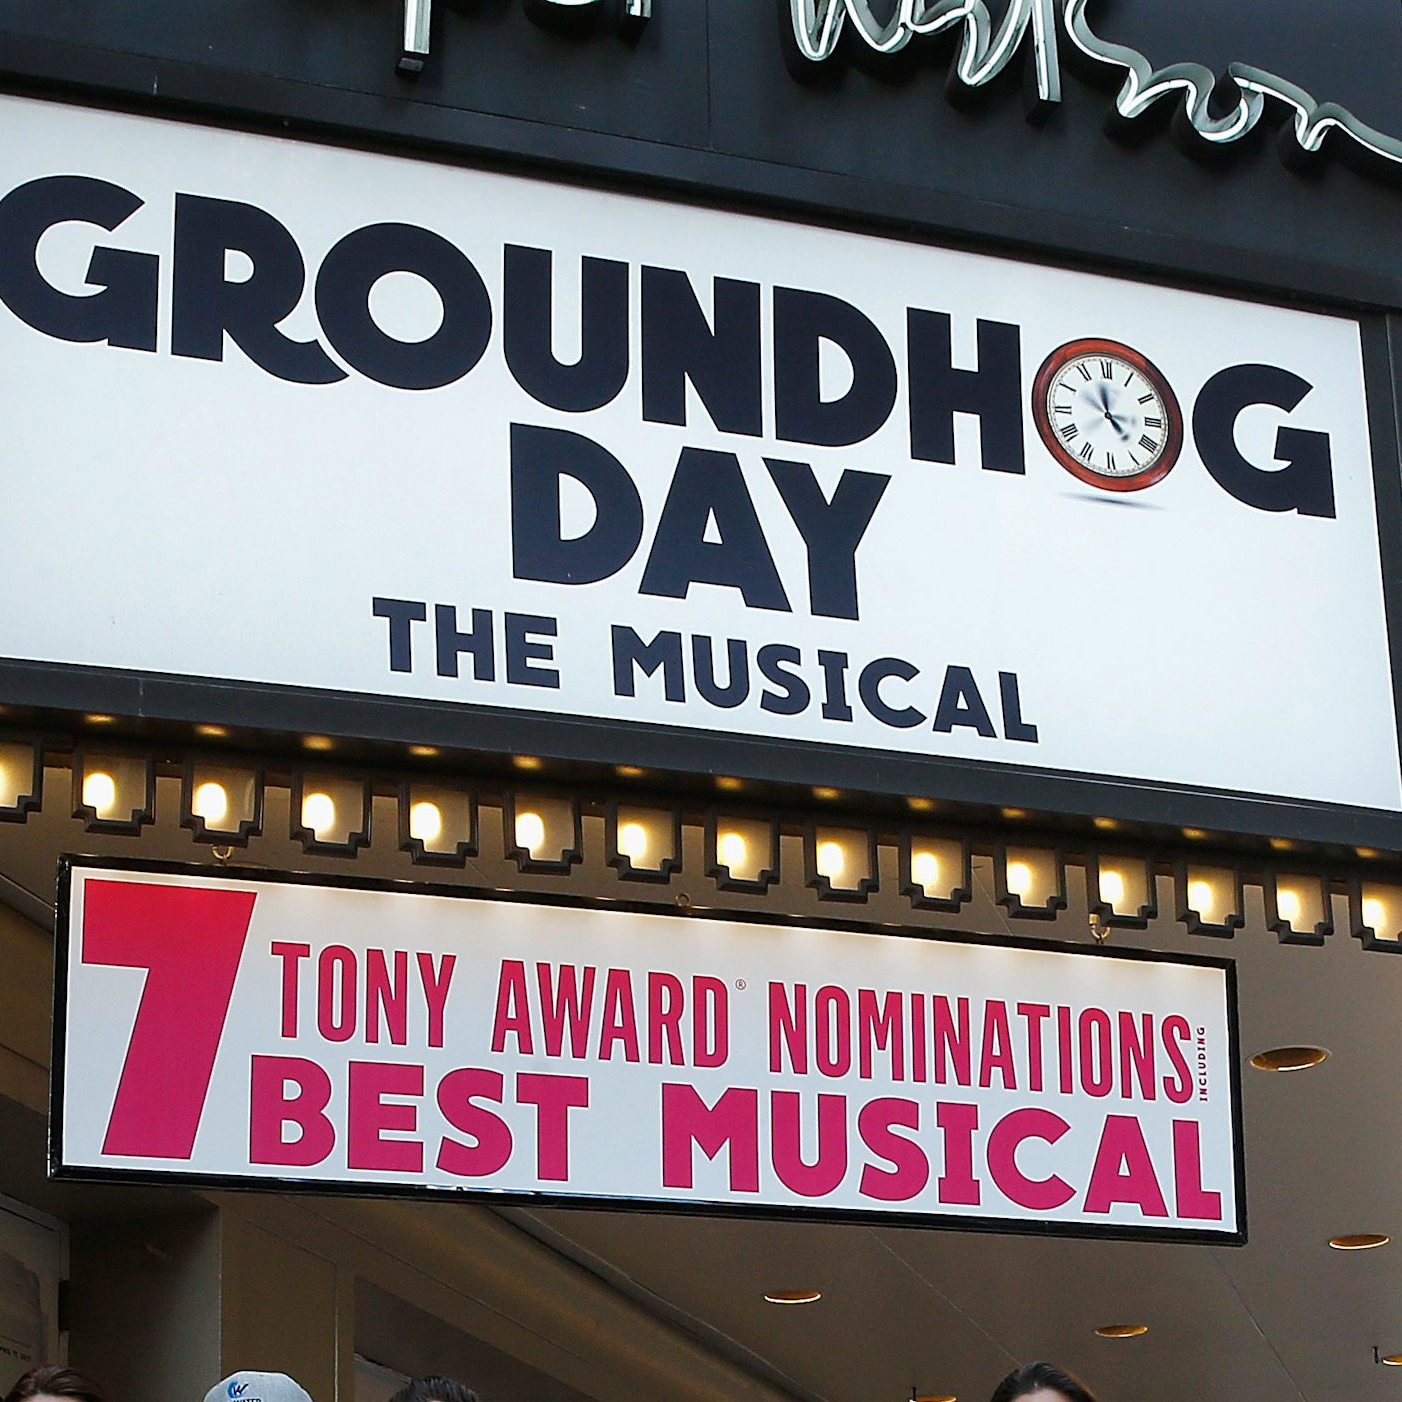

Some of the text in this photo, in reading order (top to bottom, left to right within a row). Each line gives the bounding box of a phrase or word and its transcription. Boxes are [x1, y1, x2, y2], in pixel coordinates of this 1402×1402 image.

[510, 421, 892, 621] DAY
[372, 596, 1040, 744] THE MUSICAL
[81, 878, 258, 1161] 7
[271, 940, 457, 1049] TONY
[768, 980, 1195, 1104] NOMINATIONS
[1199, 1026, 1208, 1103] INCLUDING
[249, 1054, 1223, 1221] BEST MUSICAL
